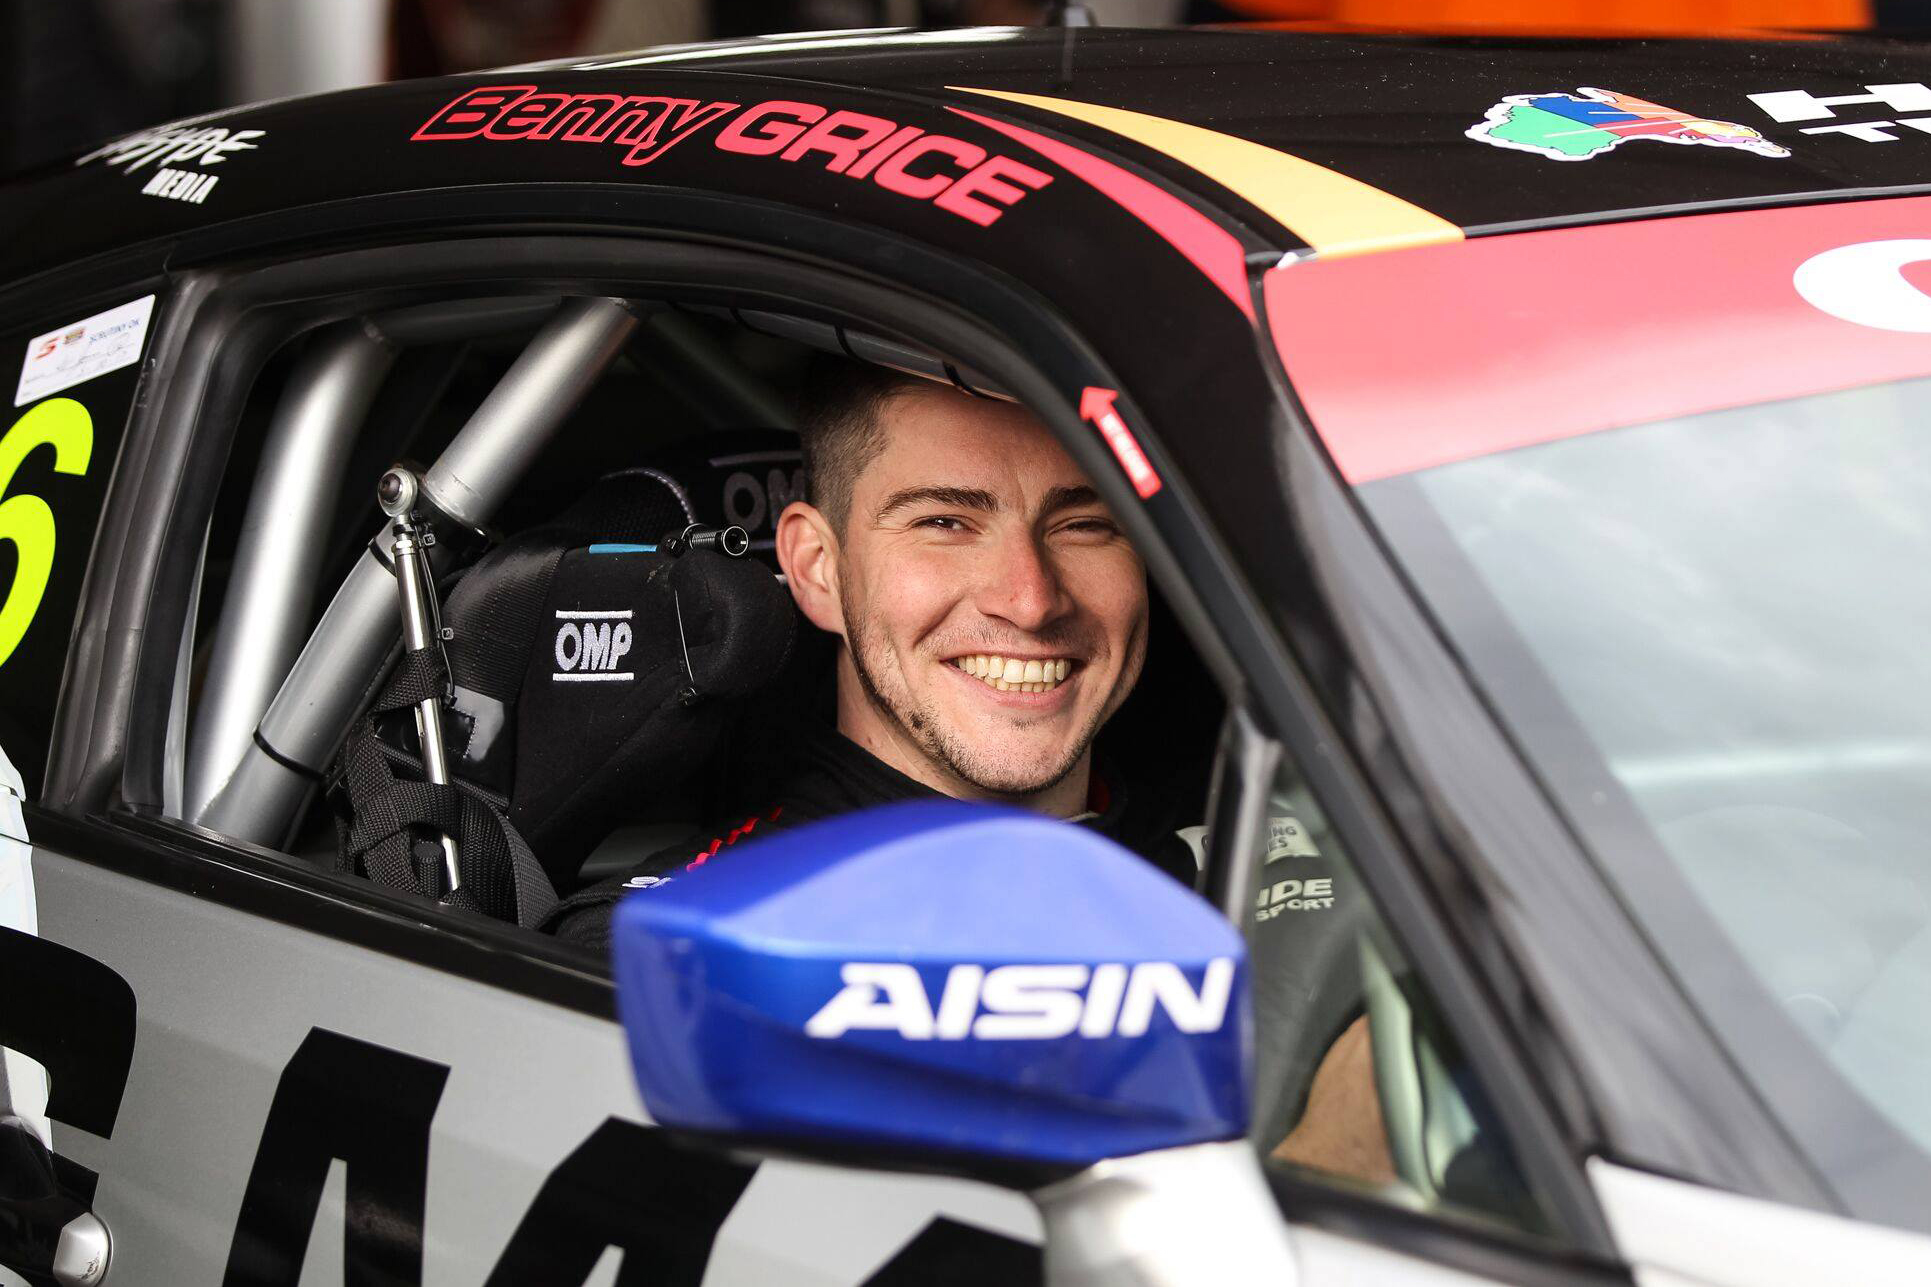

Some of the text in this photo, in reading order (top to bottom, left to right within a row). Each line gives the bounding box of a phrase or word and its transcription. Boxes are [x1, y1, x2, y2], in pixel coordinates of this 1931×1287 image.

[411, 85, 1054, 227] Benny GRICE
[141, 168, 219, 204] MEDIA
[723, 468, 806, 532] OM
[554, 621, 633, 672] OMP
[1255, 898, 1334, 921] SPORT
[1256, 878, 1333, 907] IDE
[804, 957, 1236, 1041] AISIN
